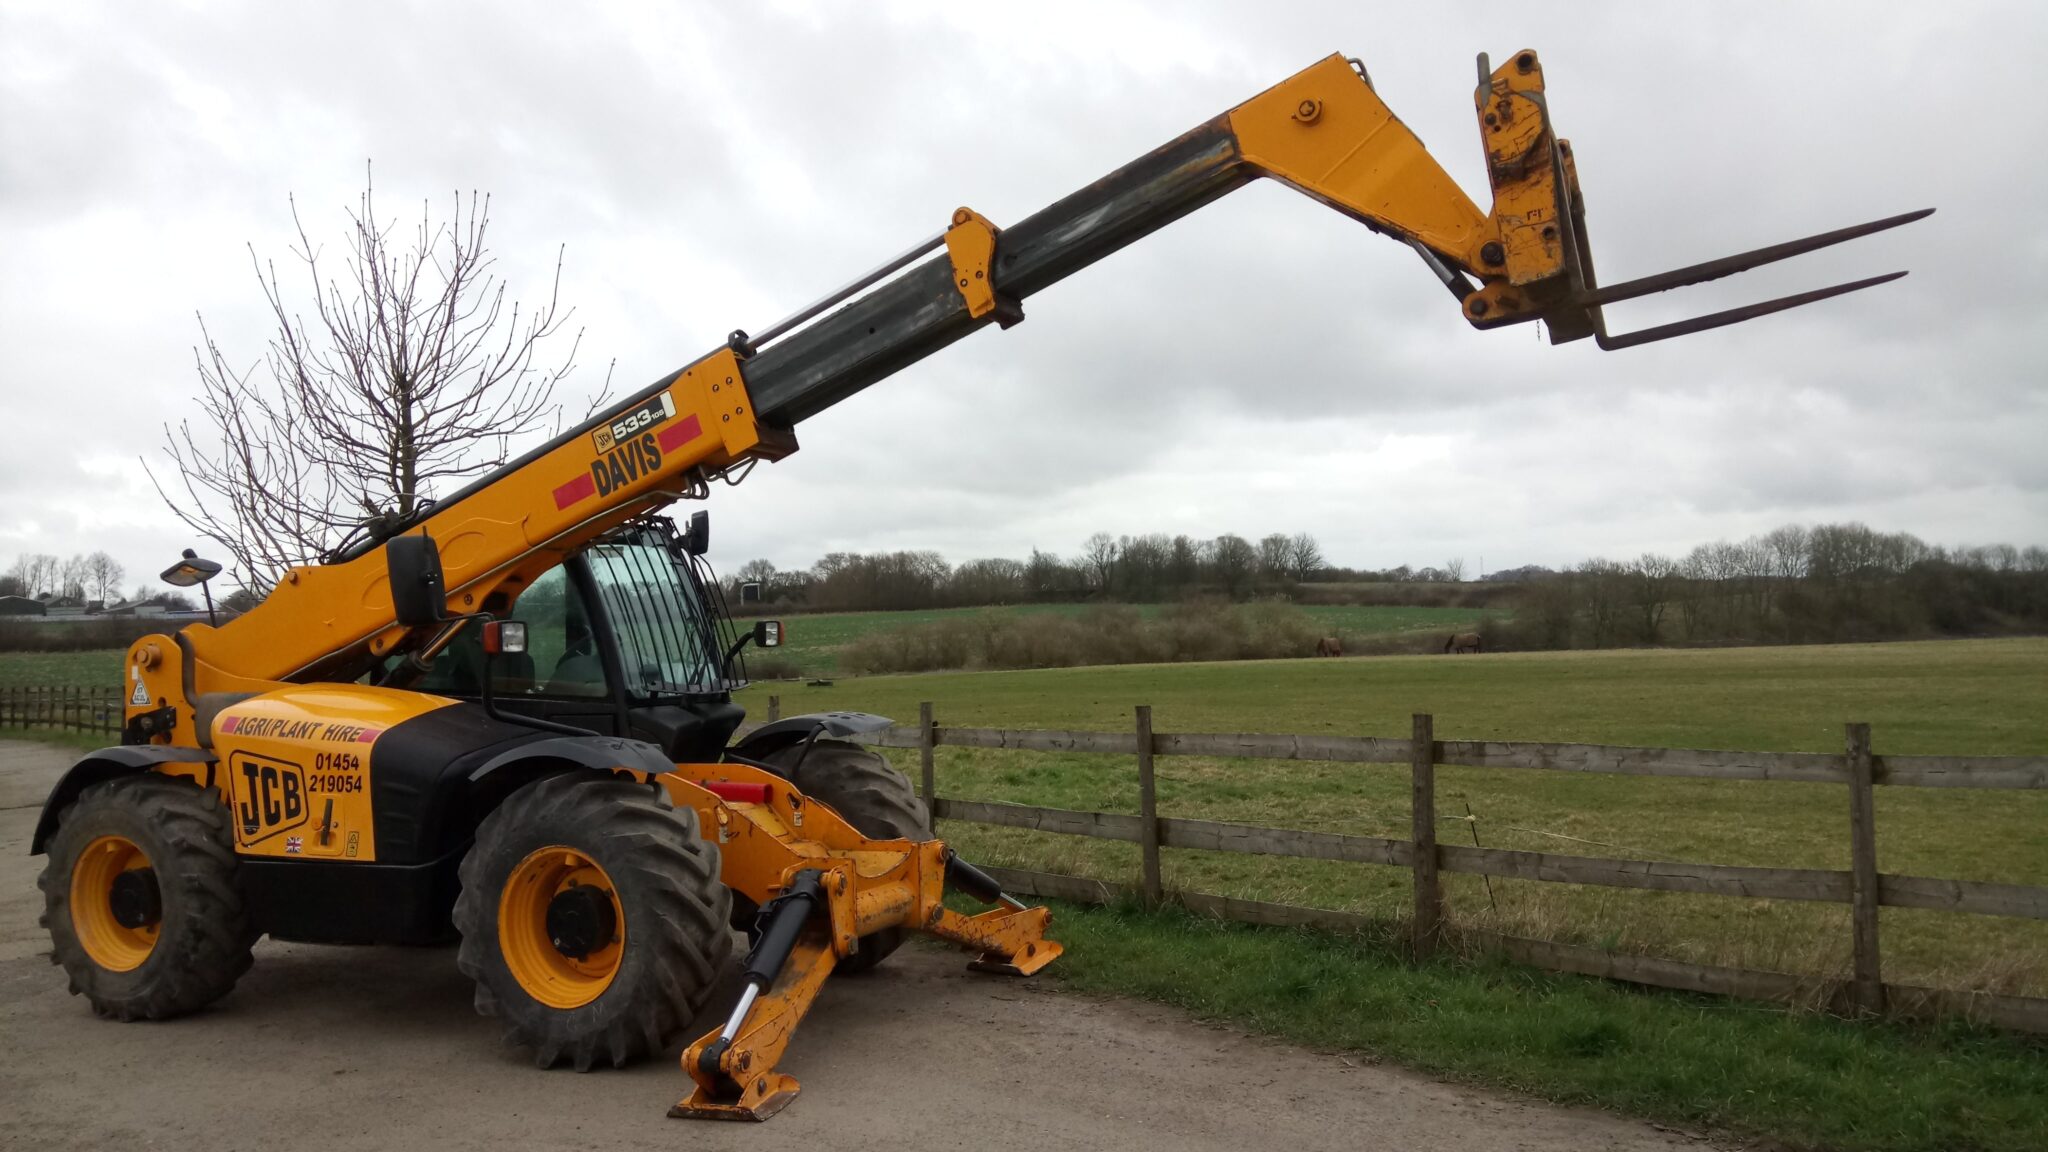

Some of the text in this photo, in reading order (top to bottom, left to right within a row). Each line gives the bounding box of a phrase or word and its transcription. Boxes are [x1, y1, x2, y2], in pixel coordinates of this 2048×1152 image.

[591, 433, 661, 497] DAVIS
[234, 717, 366, 742] AGRI/PLANT HIRE
[316, 753, 359, 771] 01454
[309, 774, 362, 793] 219054
[240, 761, 301, 836] JCB
